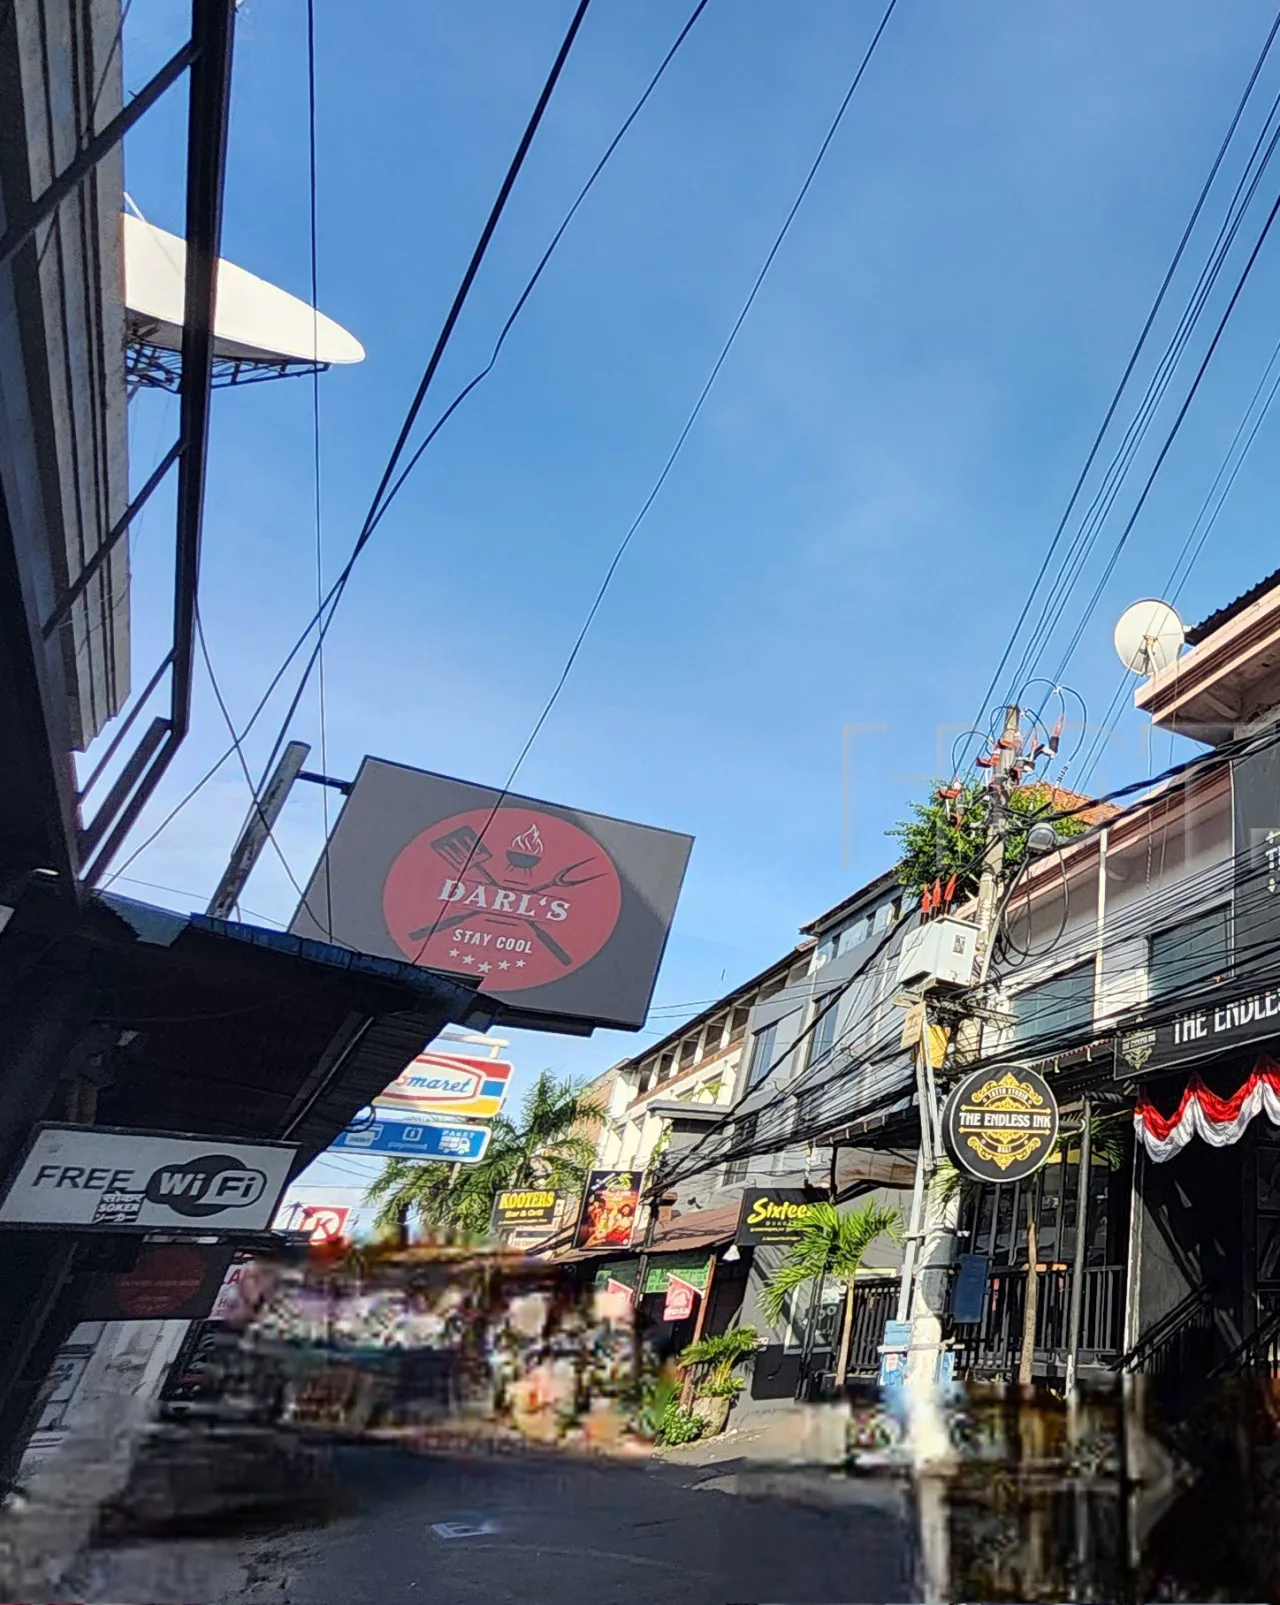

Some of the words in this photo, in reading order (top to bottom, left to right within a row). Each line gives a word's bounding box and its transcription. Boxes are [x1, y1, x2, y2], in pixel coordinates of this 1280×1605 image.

[437, 878, 571, 921] DARL'S
[452, 928, 492, 947] STAY
[496, 936, 533, 954] COOL
[1172, 1012, 1207, 1045] THE
[959, 1112, 982, 1126] THE
[984, 1113, 1030, 1128] ENDLESS
[1032, 1115, 1052, 1128] INK
[32, 1164, 136, 1191] FREE
[160, 1171, 257, 1198] WiFi
[98, 1203, 141, 1212] SOKER
[498, 1191, 555, 1210] KOOTERS
[747, 1196, 812, 1224] Sixtee
[505, 1210, 520, 1218] Bar
